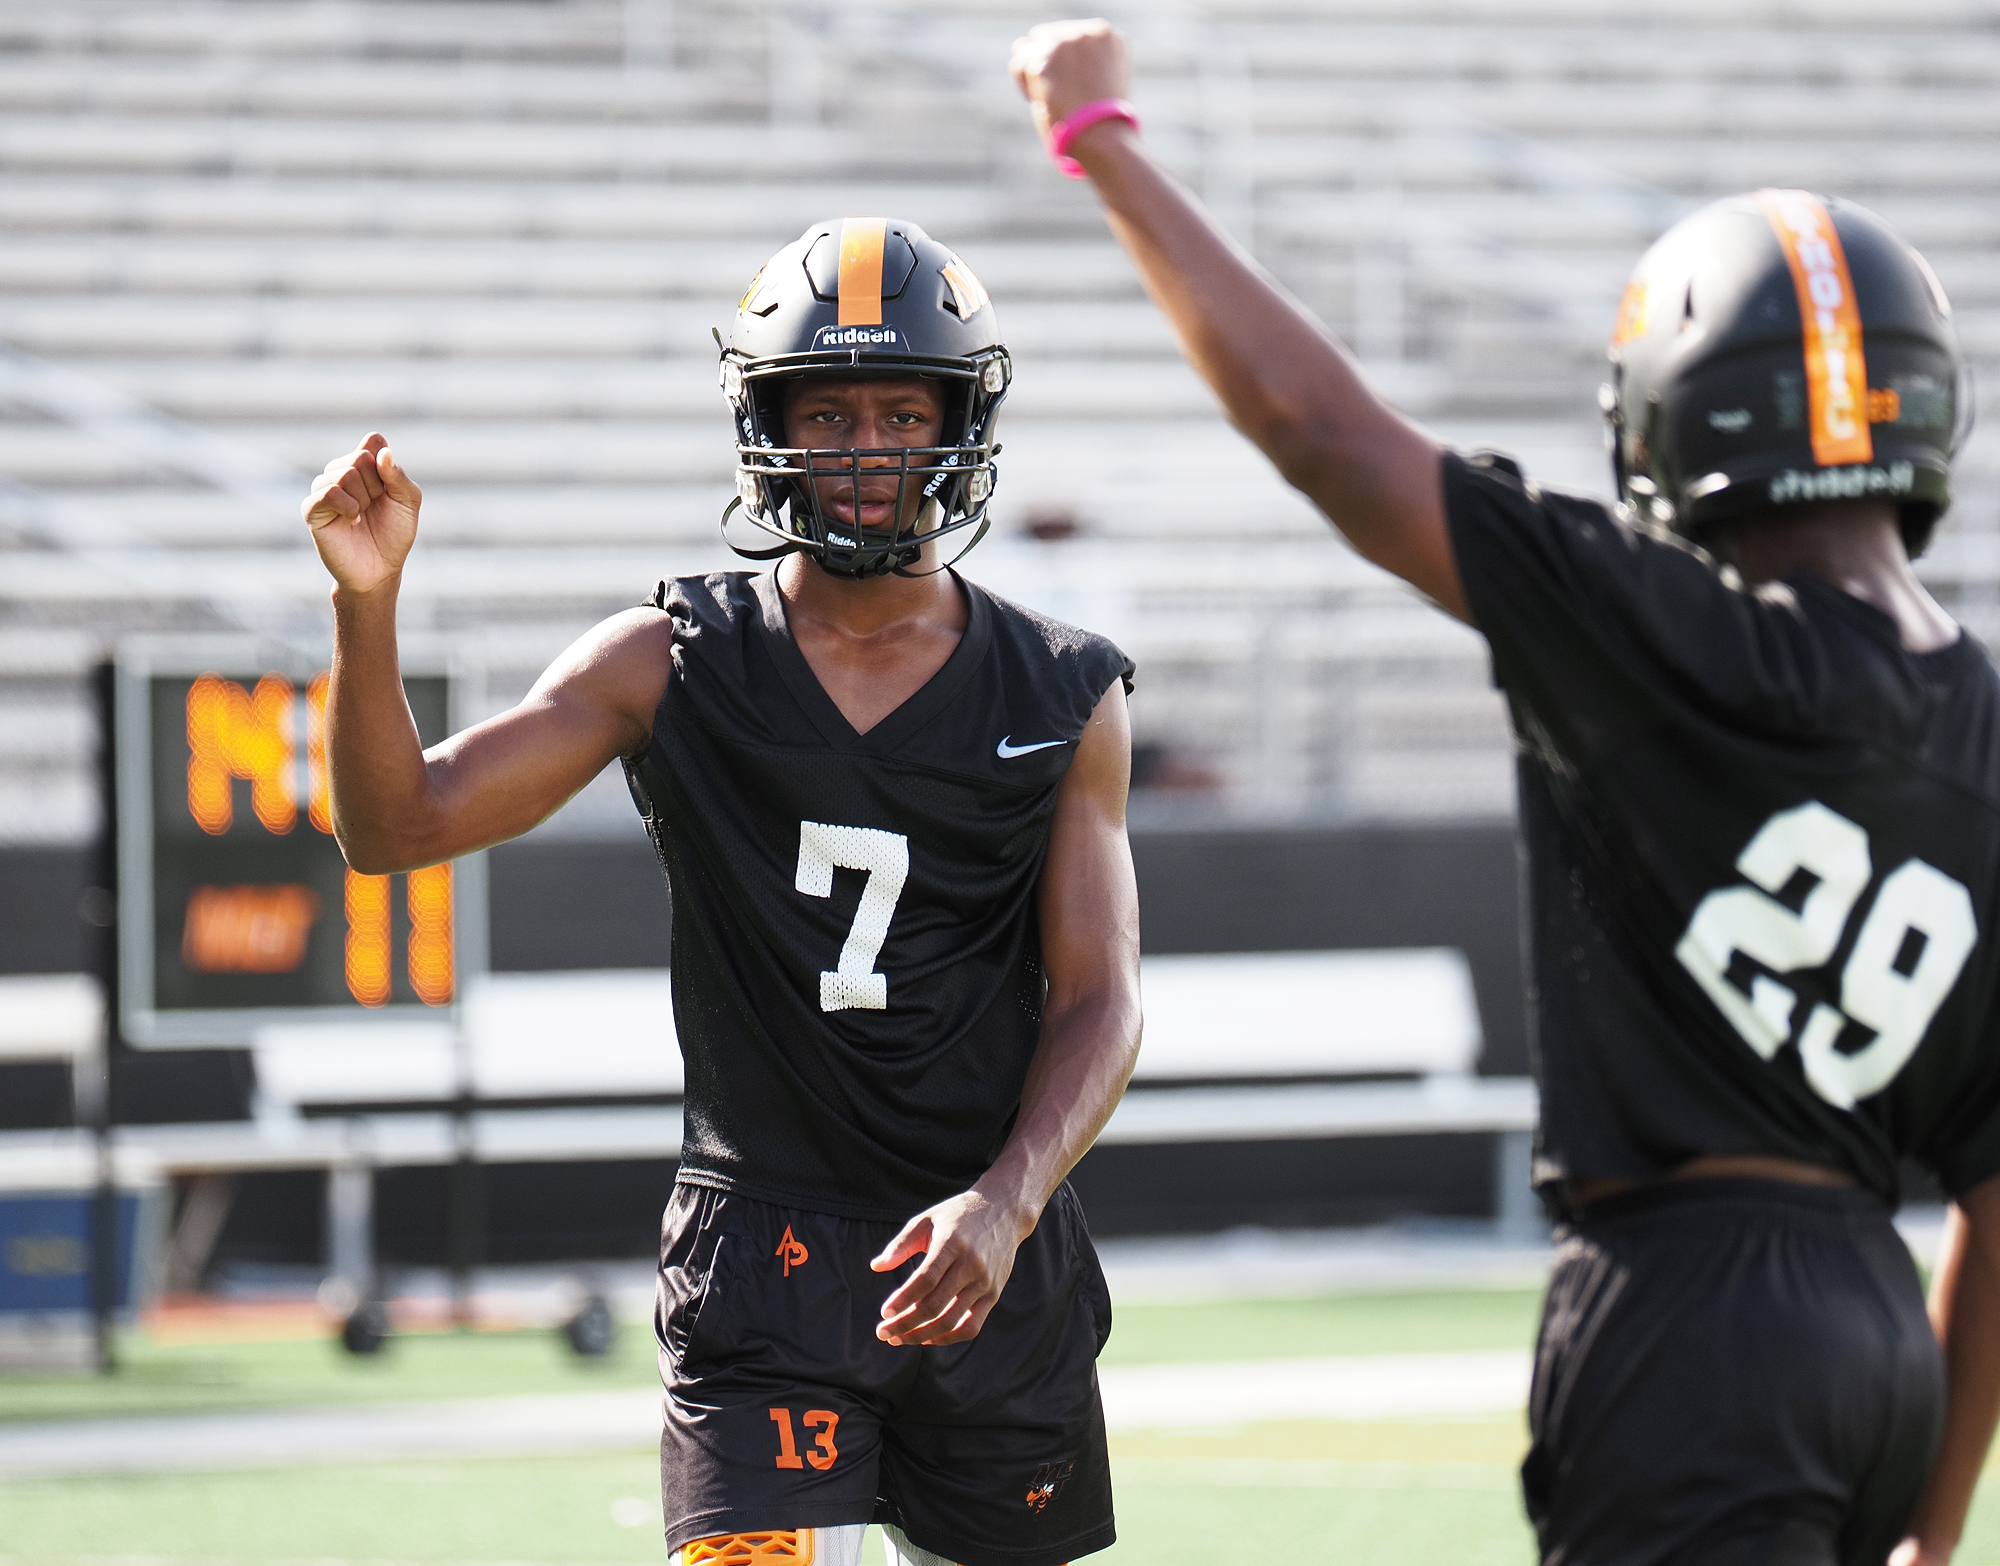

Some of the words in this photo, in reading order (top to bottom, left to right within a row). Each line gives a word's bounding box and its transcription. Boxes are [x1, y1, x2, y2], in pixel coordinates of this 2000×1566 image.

[823, 327, 896, 345] Riddell
[795, 820, 910, 1012] 7
[1674, 800, 1978, 1112] 29
[769, 1408, 840, 1470] 13
